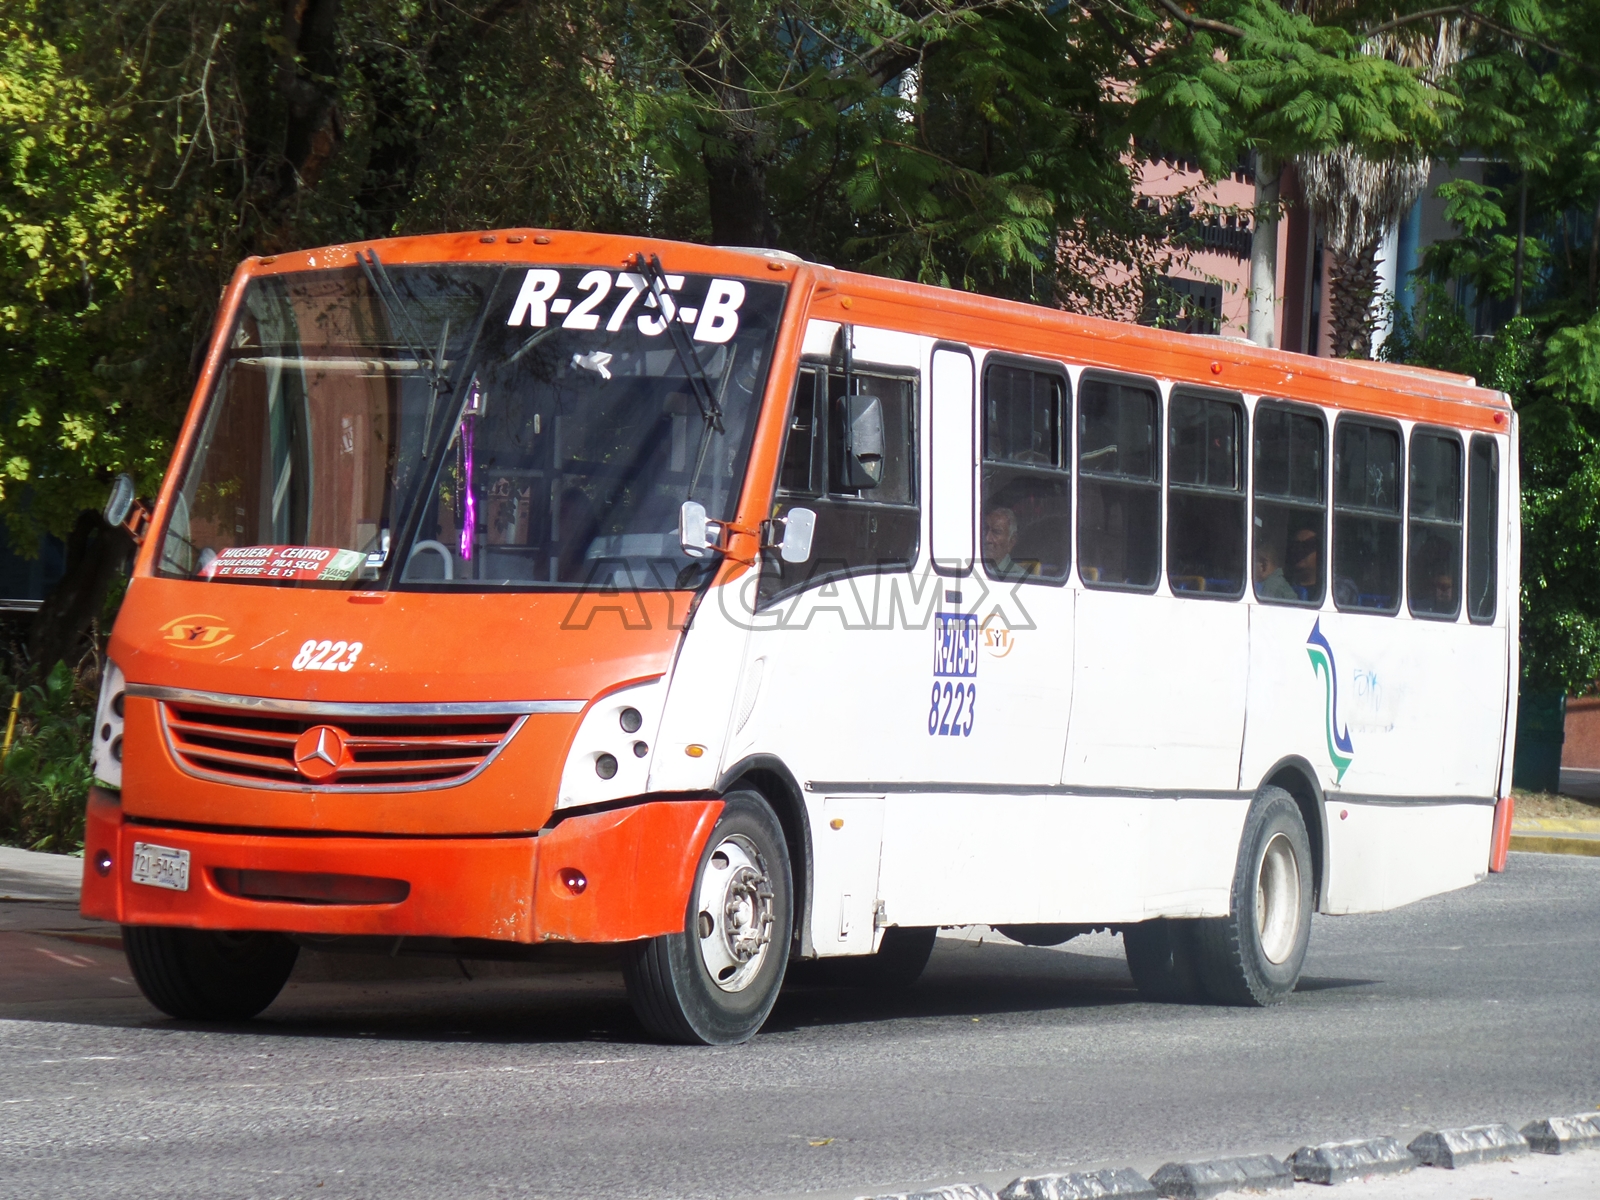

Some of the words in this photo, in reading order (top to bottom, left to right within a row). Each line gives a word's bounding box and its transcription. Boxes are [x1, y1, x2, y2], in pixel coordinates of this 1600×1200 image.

[507, 269, 746, 344] R-275-B
[221, 548, 274, 558] HIGUERA
[280, 547, 330, 561] CENTRO
[271, 560, 293, 568] PILA
[292, 561, 319, 570] SECA
[219, 567, 231, 575] EL
[232, 567, 263, 575] VERDE
[267, 568, 280, 576] EL
[282, 569, 296, 577] 15
[292, 640, 363, 672] 8223
[934, 616, 977, 675] R-275-B
[928, 680, 976, 738] 8223
